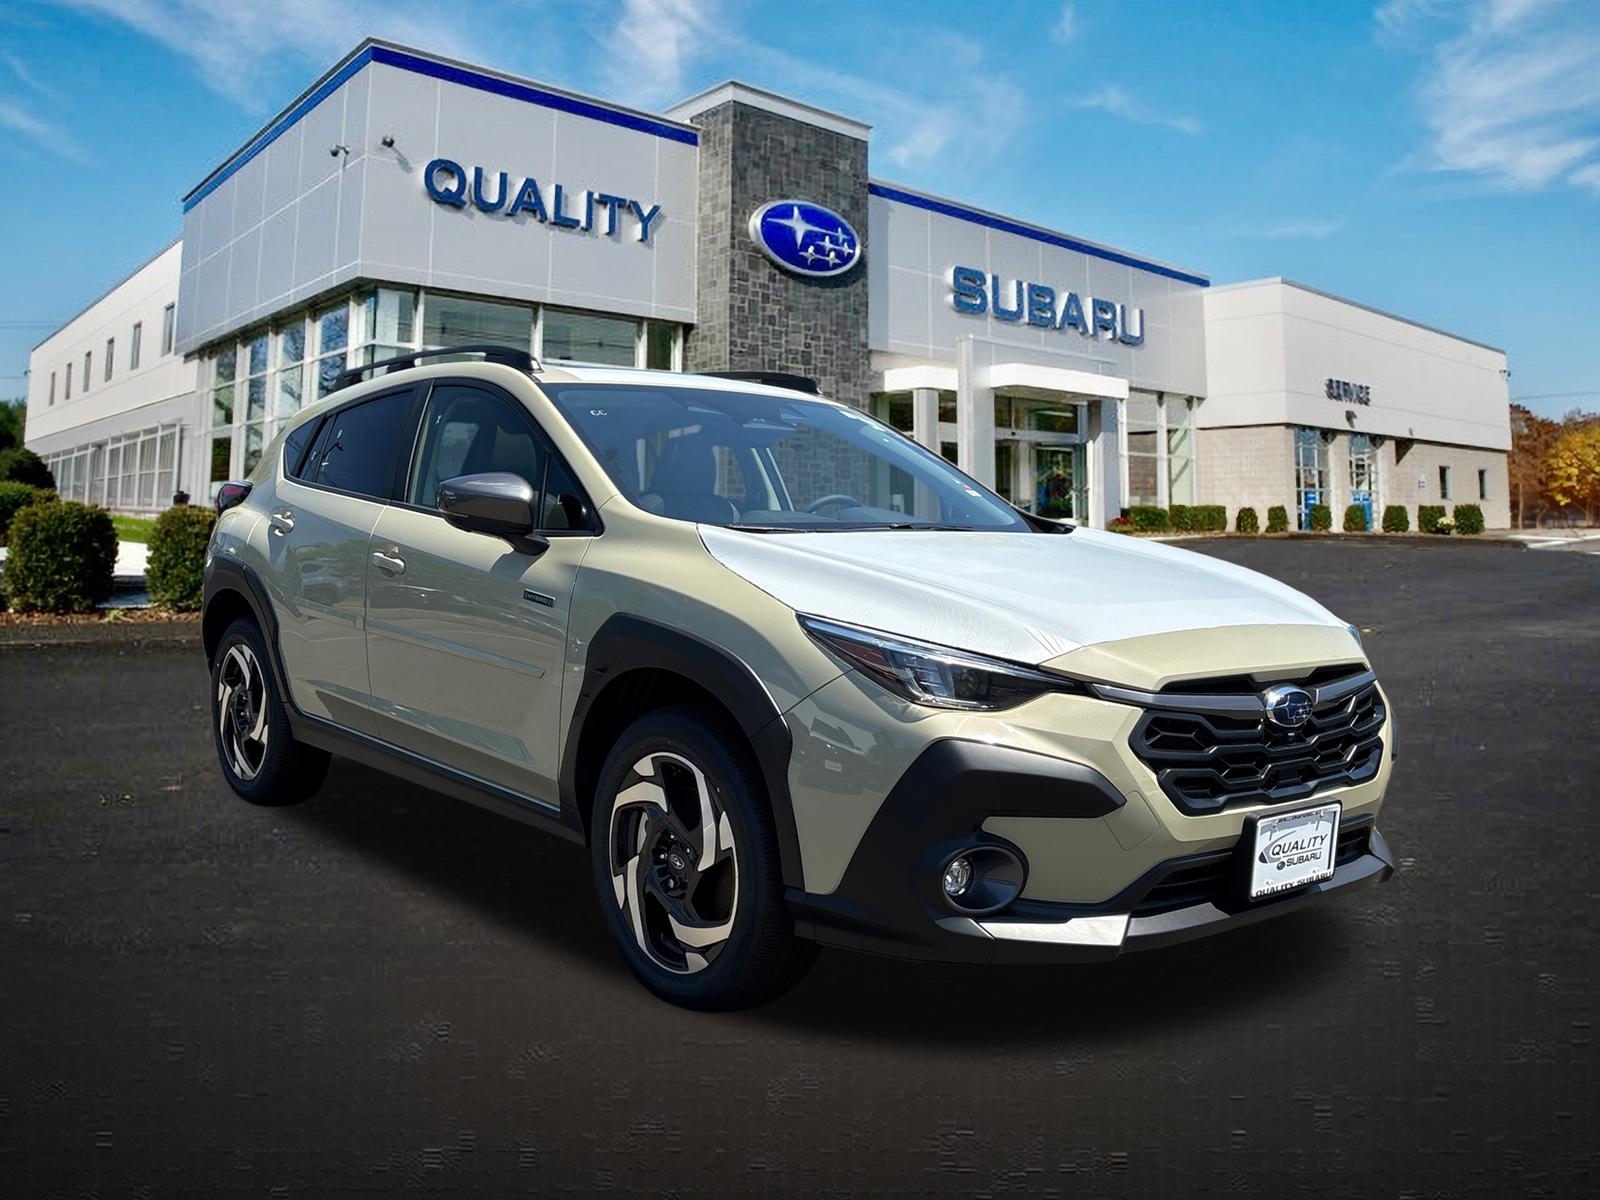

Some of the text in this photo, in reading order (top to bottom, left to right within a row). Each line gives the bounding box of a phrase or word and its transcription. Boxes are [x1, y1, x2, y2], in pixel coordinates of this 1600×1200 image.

[424, 158, 661, 242] QUALITY
[951, 265, 1145, 346] SUBARU
[1272, 834, 1328, 856] QUALITY
[1286, 851, 1321, 866] SUBARU
[1256, 872, 1333, 896] QUALITY SUBARU
